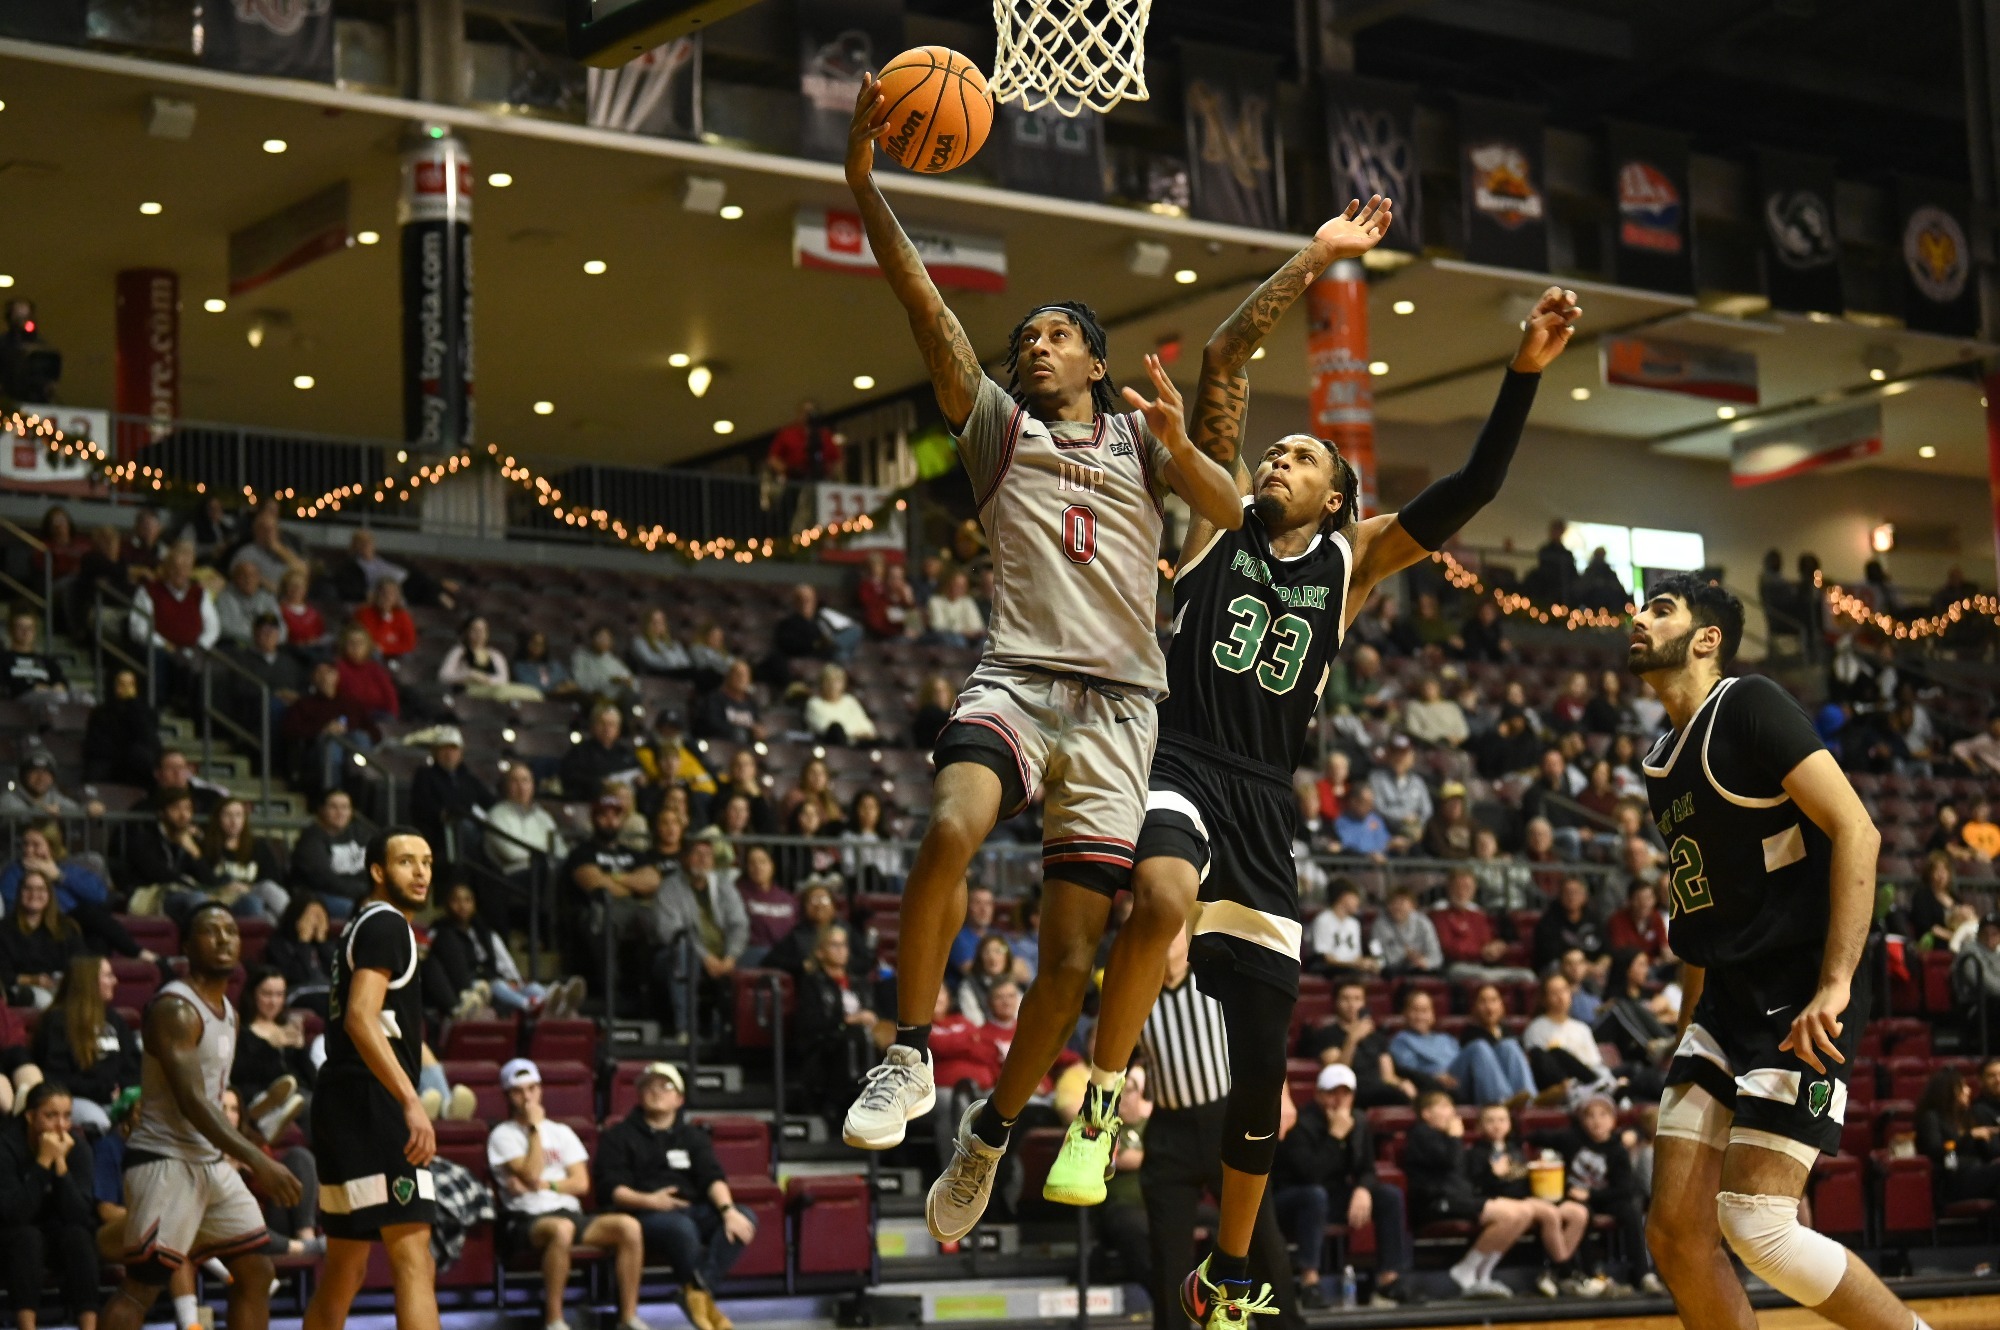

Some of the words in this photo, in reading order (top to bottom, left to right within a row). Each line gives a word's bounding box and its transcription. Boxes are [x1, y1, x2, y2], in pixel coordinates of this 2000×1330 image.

[1057, 462, 1105, 494] IUP
[1062, 504, 1098, 565] 0
[1276, 585, 1330, 611] PARK
[1212, 594, 1313, 696] 33
[1670, 834, 1714, 920] 2
